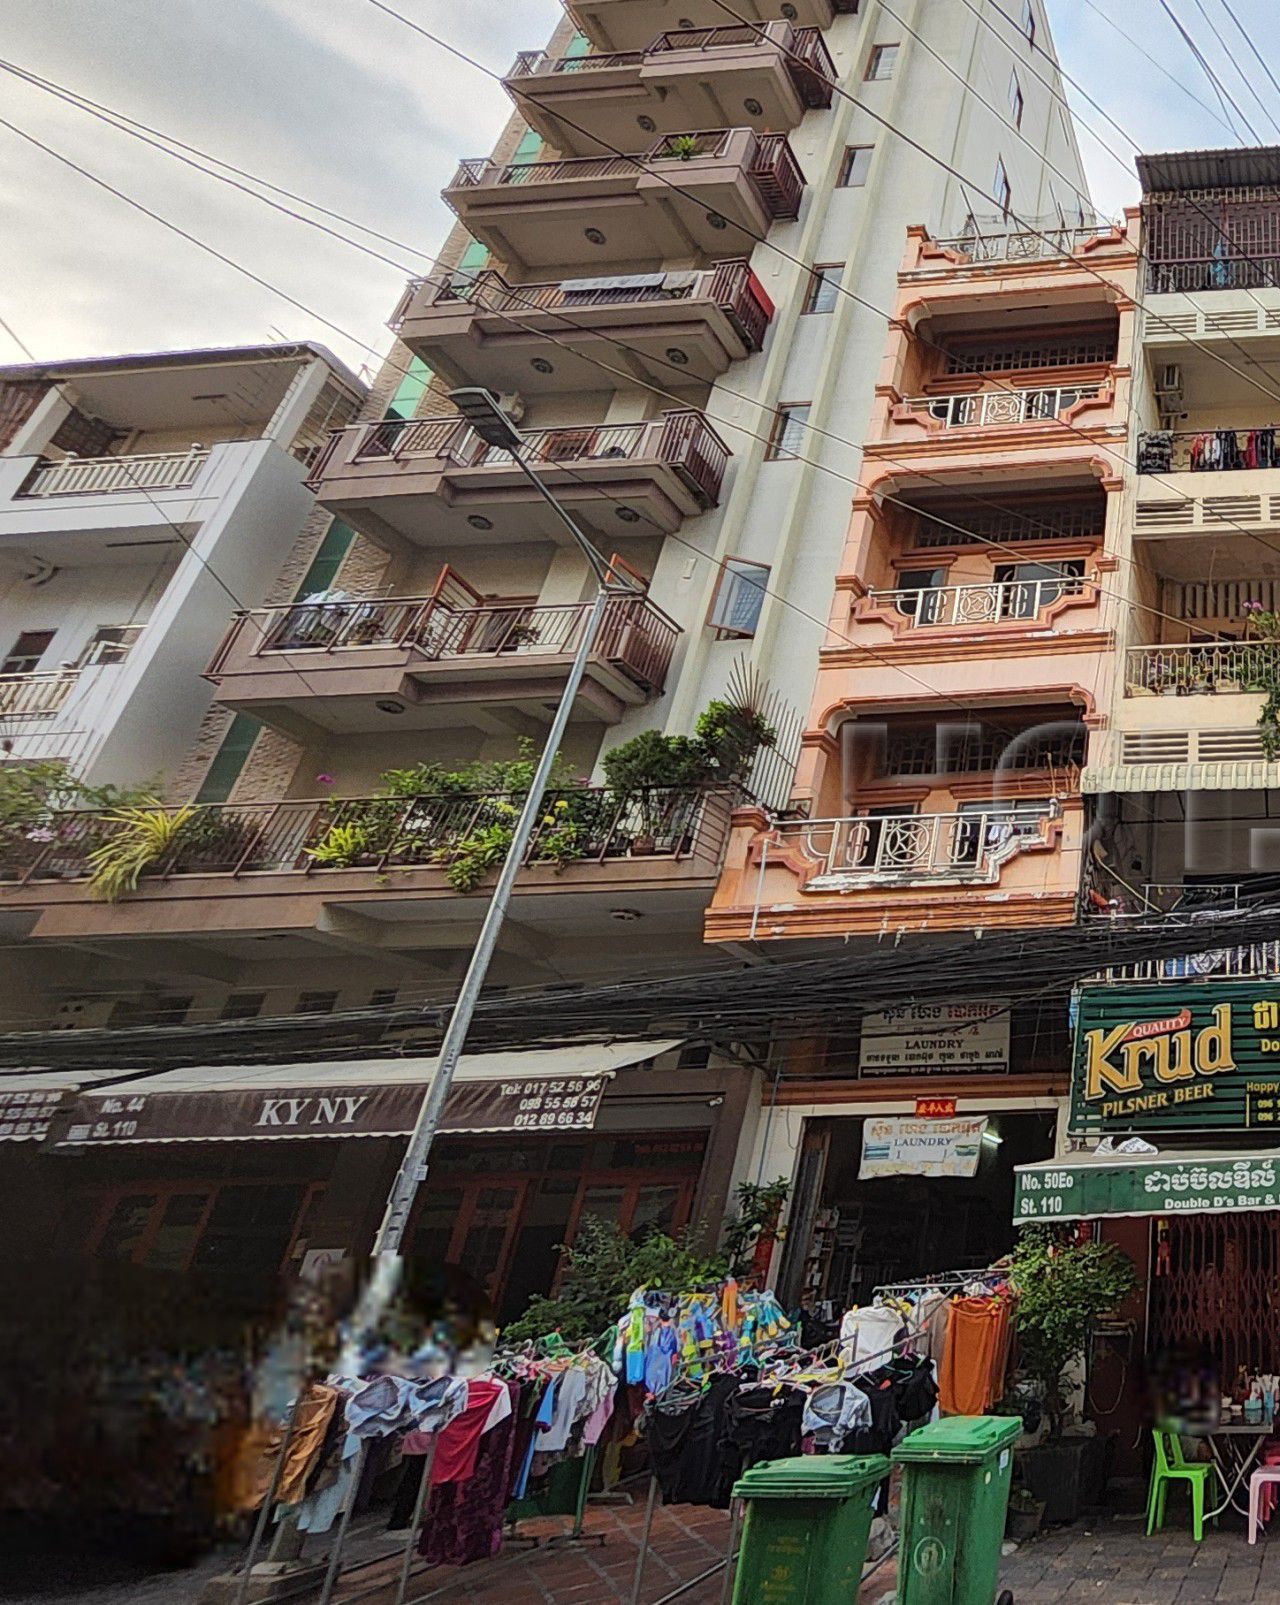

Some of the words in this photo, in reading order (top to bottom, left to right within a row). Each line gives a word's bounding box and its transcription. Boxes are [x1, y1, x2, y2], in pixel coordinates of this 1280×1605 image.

[1132, 1017, 1187, 1037] QUALITY
[905, 1039, 965, 1050] LAUNDRY
[1084, 1003, 1237, 1101] Krud
[1246, 1082, 1280, 1093] Happy
[125, 1098, 145, 1112] 44
[1103, 1092, 1168, 1117] PILSNER
[1174, 1084, 1214, 1103] BEER
[254, 1098, 312, 1126] KY
[310, 1096, 369, 1125] NY
[894, 1137, 953, 1147] LAUNDRY
[1021, 1174, 1041, 1190] No.
[1044, 1172, 1074, 1189] 50Eo
[1020, 1199, 1037, 1214] St.
[1040, 1196, 1063, 1212] 110
[1164, 1198, 1211, 1210] Double
[1213, 1196, 1235, 1208] D's
[1237, 1195, 1263, 1206] Bar
[1264, 1193, 1276, 1205] &
